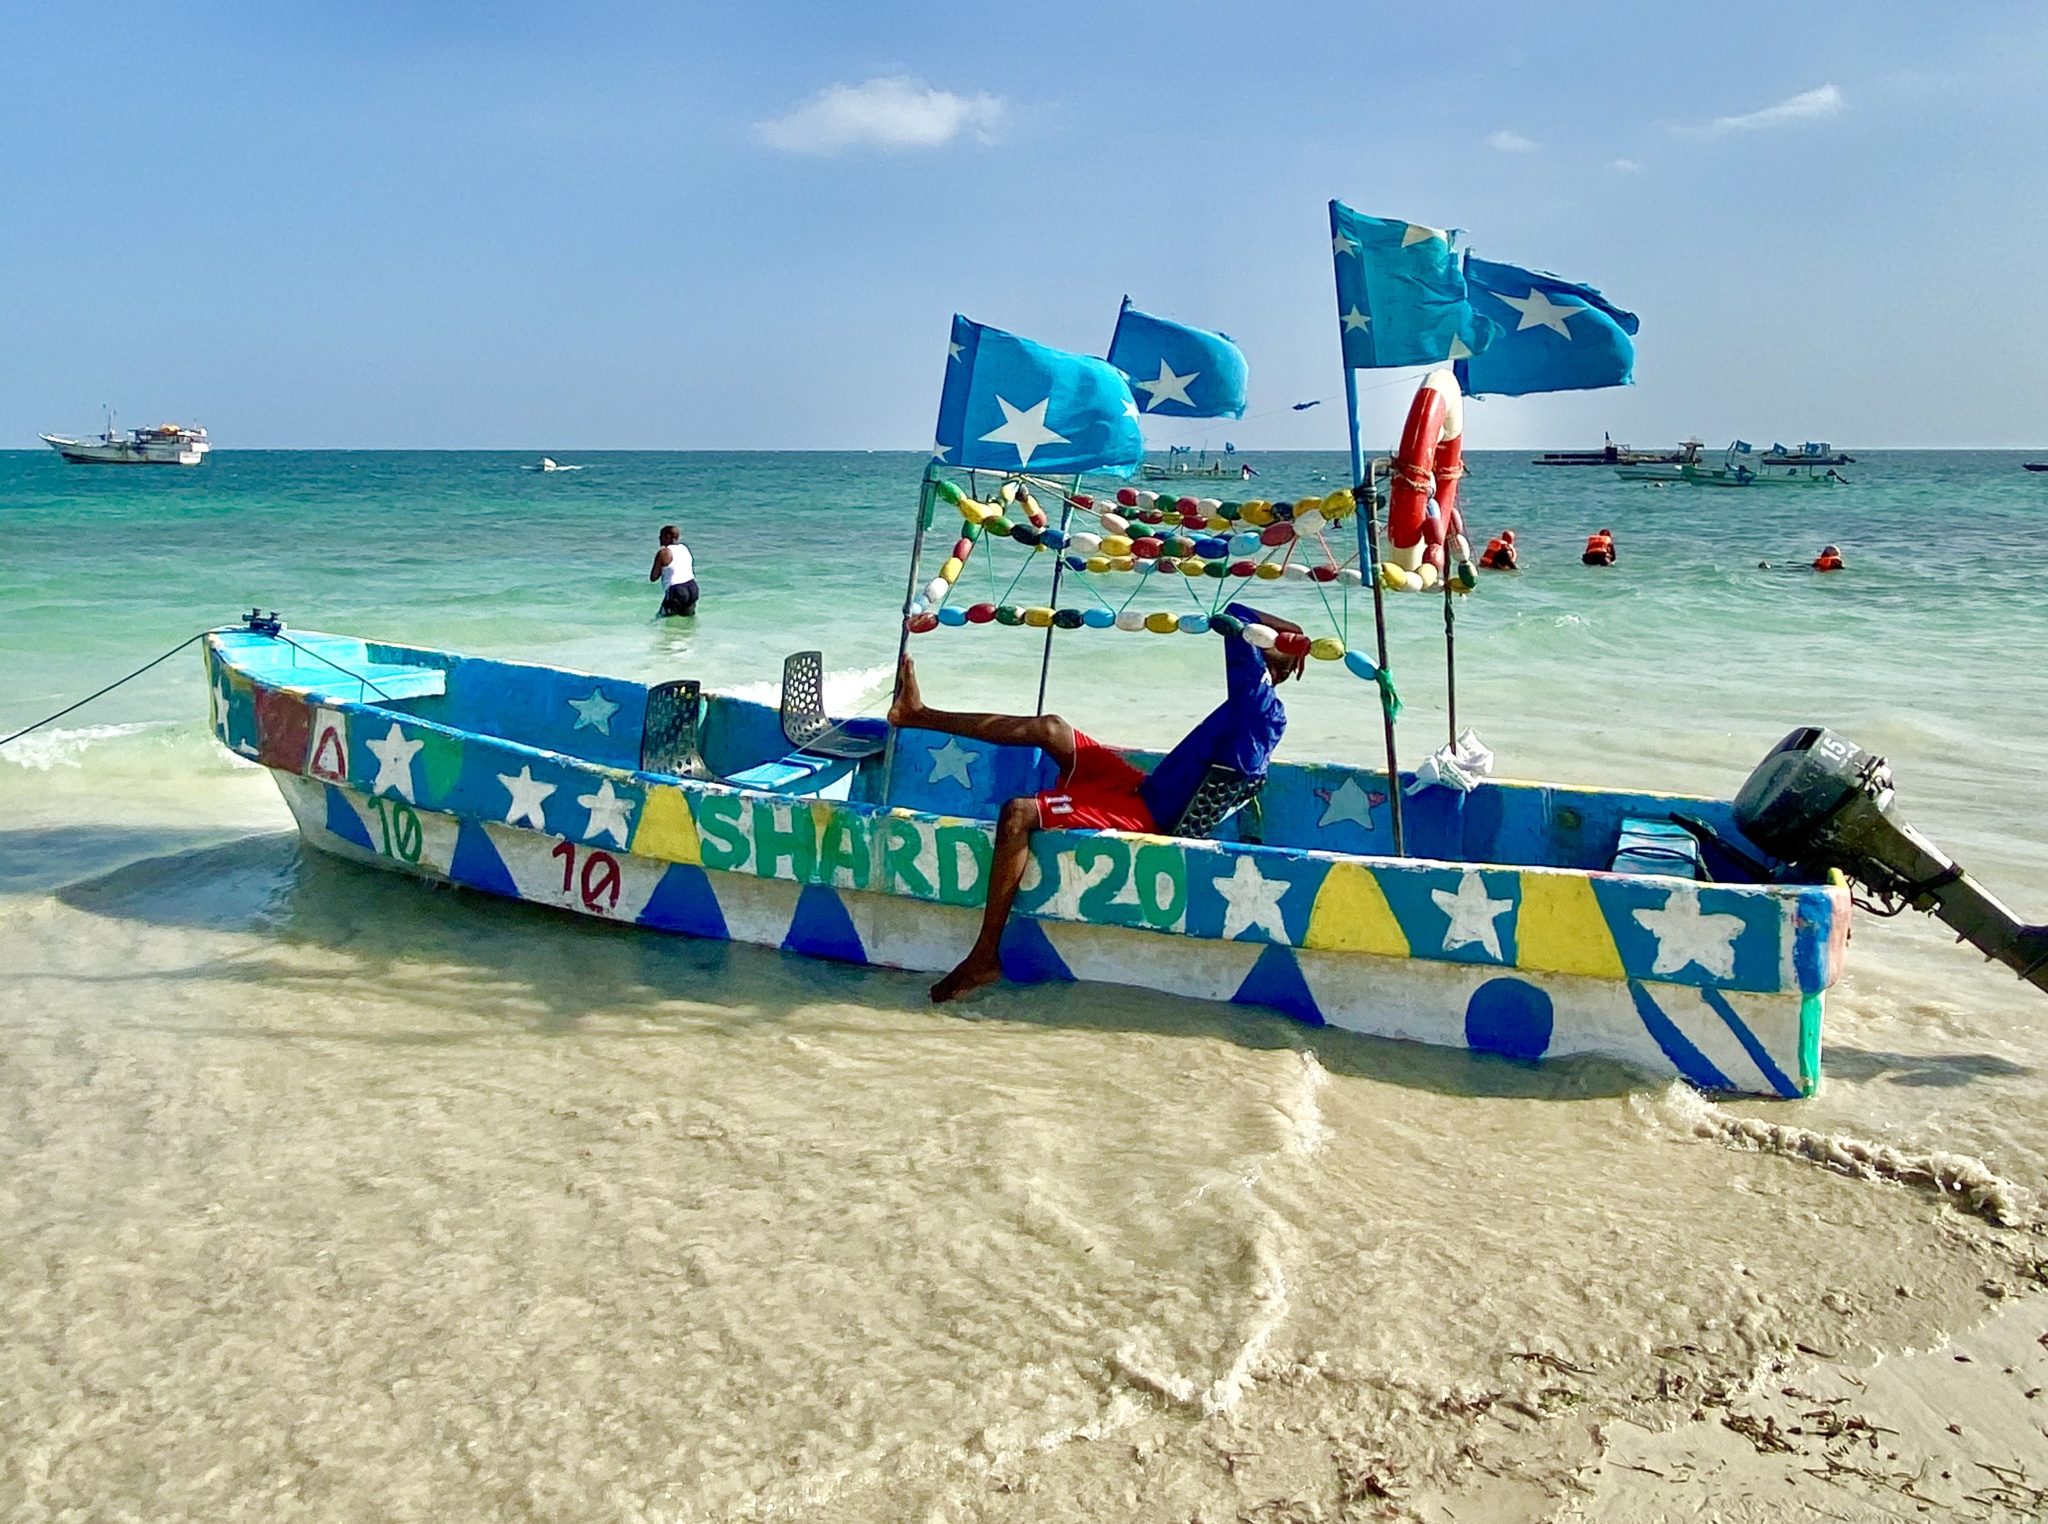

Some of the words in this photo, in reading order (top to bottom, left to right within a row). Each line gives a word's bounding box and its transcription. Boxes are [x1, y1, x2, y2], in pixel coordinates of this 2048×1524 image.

[1820, 737, 1847, 762] 15
[369, 795, 422, 864] 10
[552, 840, 621, 912] 10
